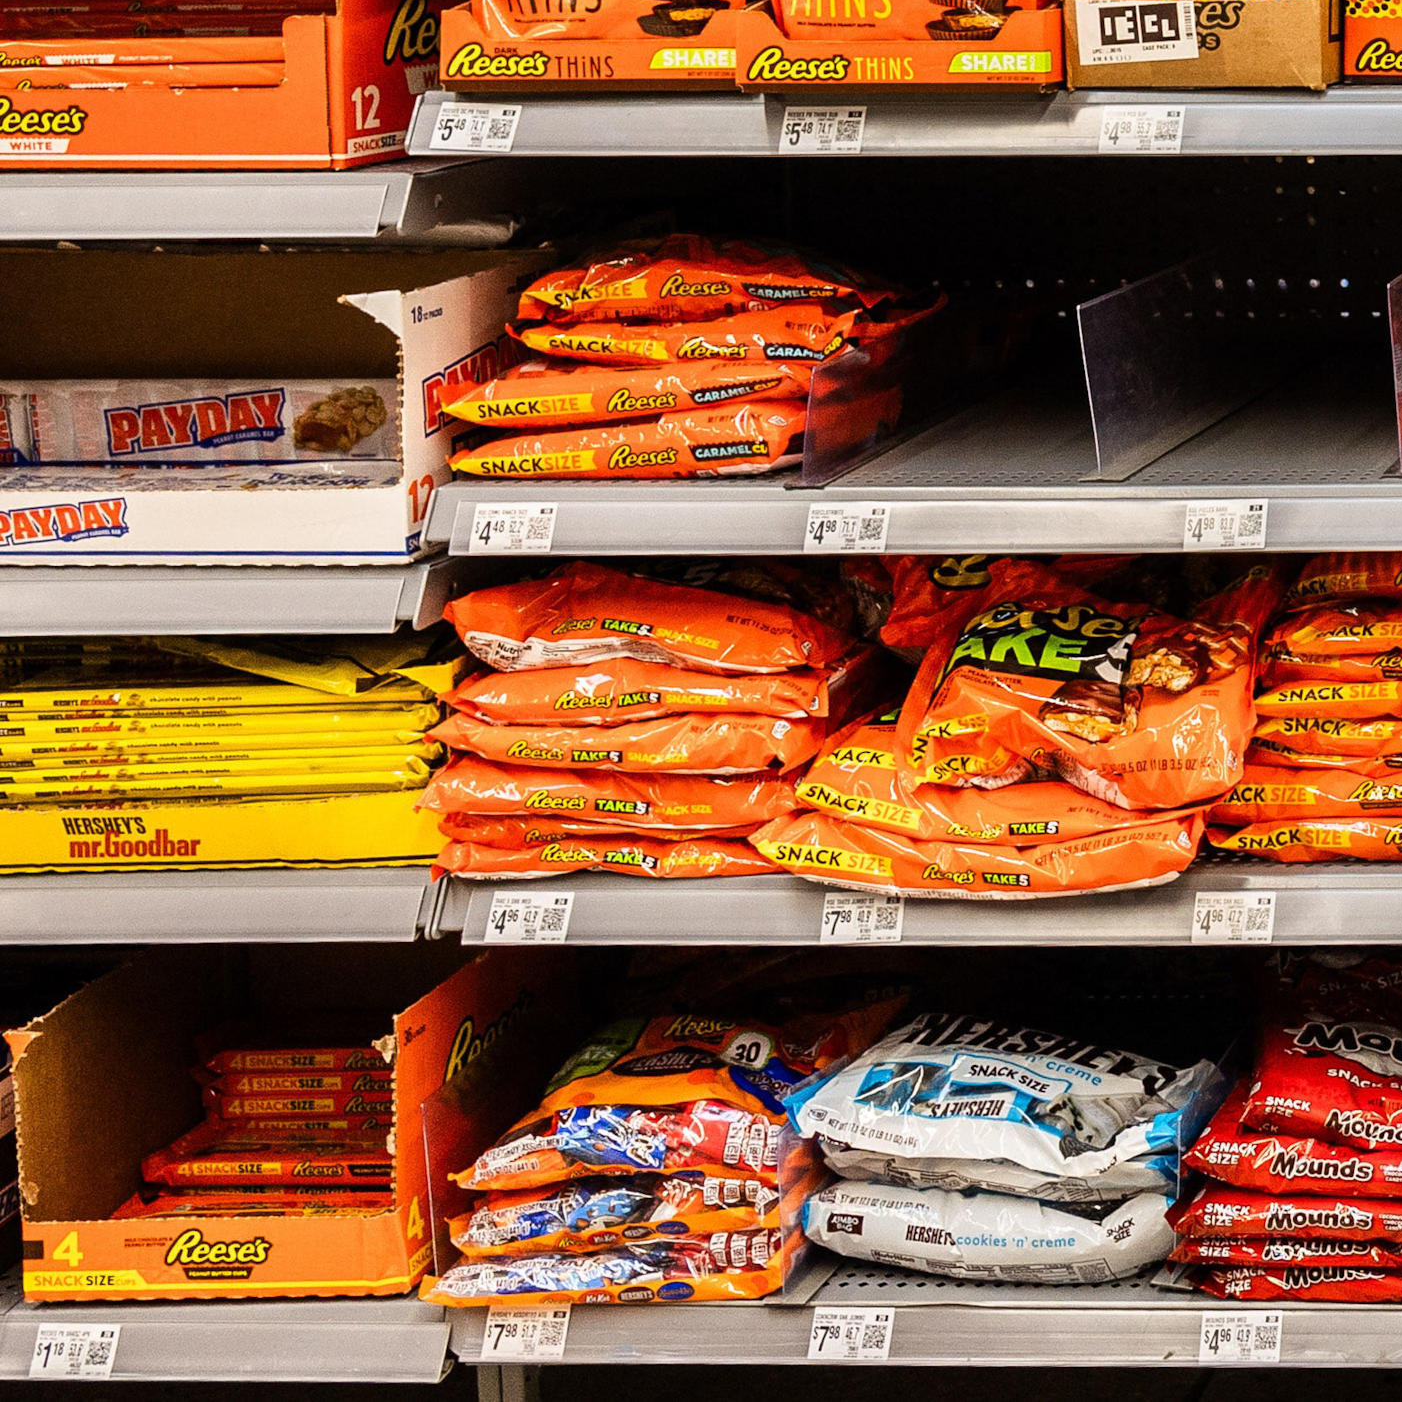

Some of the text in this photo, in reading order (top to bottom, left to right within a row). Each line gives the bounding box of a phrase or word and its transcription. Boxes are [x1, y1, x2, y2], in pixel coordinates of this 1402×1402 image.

[352, 85, 380, 130] 12
[10, 141, 52, 151] WHITE
[410, 305, 423, 323] 18
[109, 393, 287, 453] PAYDAY
[62, 817, 145, 836] HERSHEY'S
[69, 829, 200, 858] mr.Goodbar
[776, 846, 888, 873] SNACK SIZE
[735, 1042, 761, 1061] 30
[969, 1063, 1018, 1084] SNACK
[1271, 1150, 1373, 1182] Mounds
[53, 1232, 85, 1267] 4
[165, 1230, 272, 1267] Reese's
[957, 1234, 1007, 1249] cookies
[1032, 1234, 1075, 1248] creme
